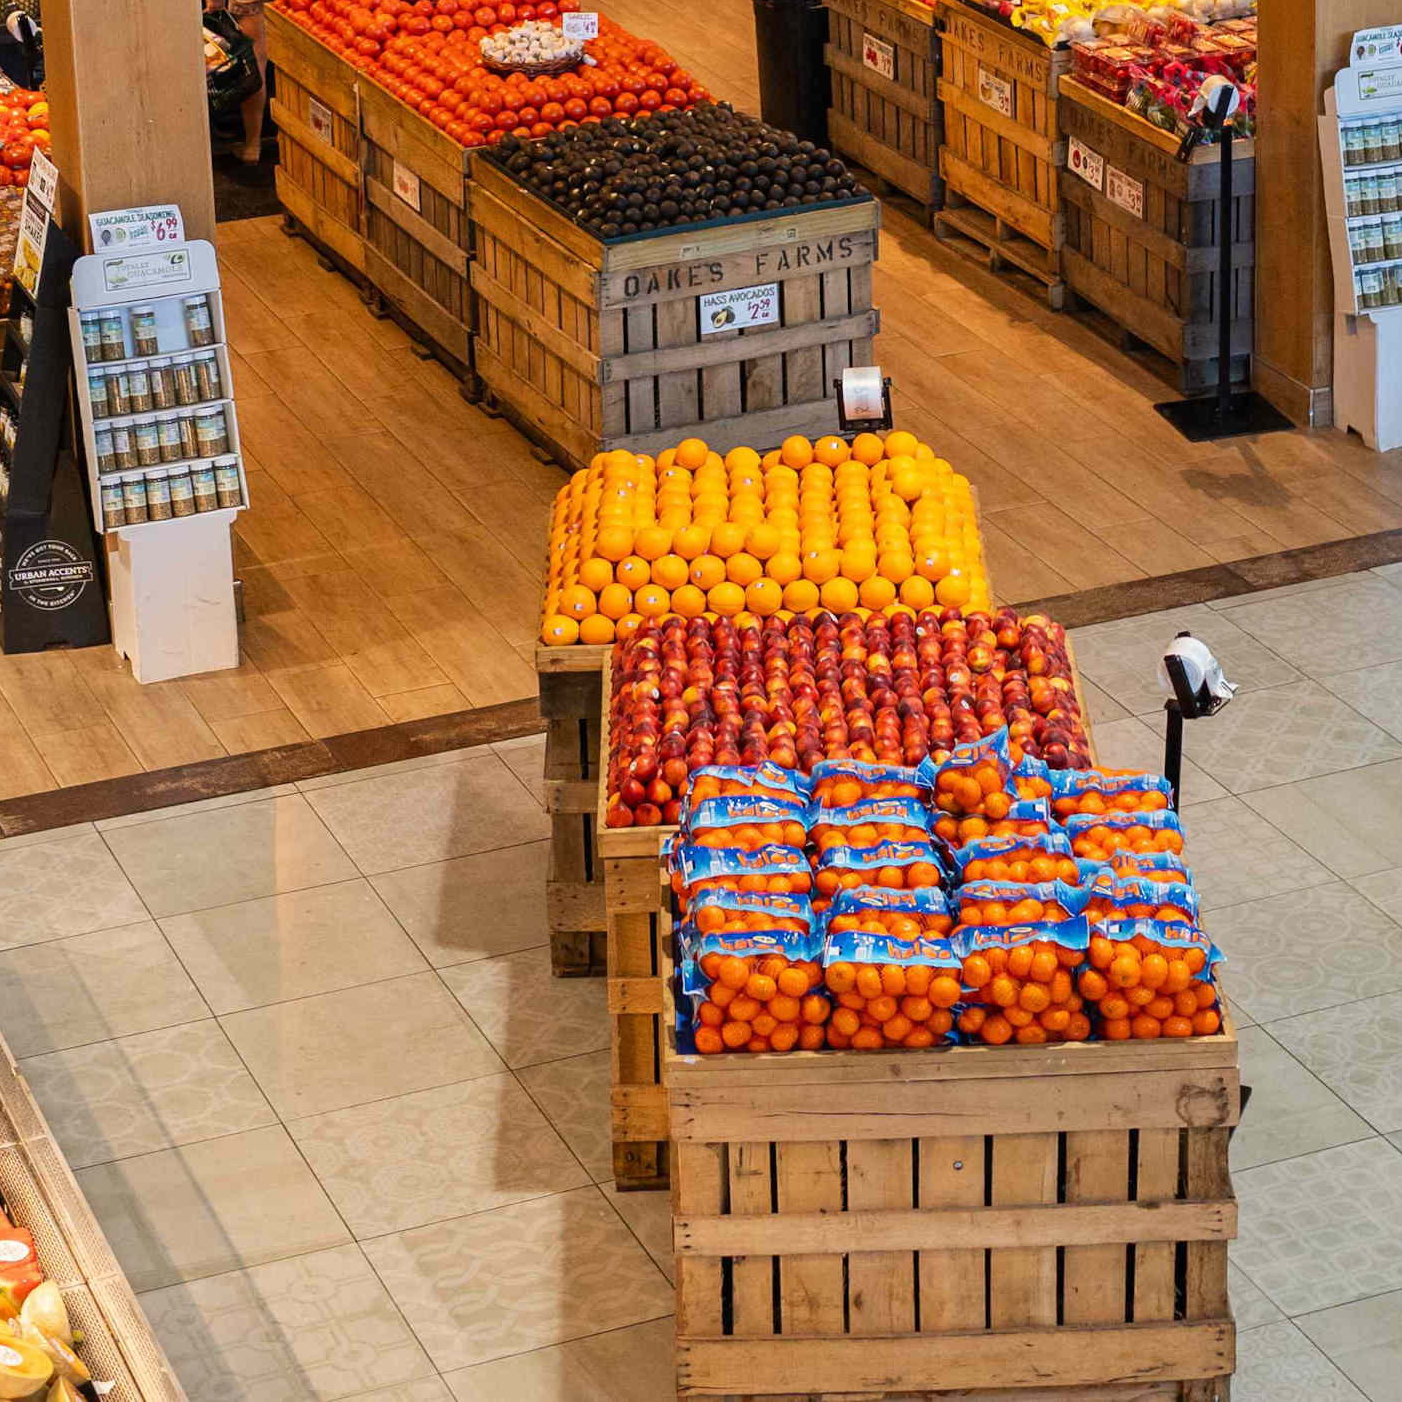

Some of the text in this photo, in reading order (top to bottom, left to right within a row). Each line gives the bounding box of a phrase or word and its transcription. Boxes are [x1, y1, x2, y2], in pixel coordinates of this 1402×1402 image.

[96, 209, 176, 228] GUACAMOLE SEASONING
[623, 236, 853, 299] OAKES FARMS
[703, 286, 775, 307] HASS AVOCADOS
[14, 565, 88, 581] URBAN ACCENTS
